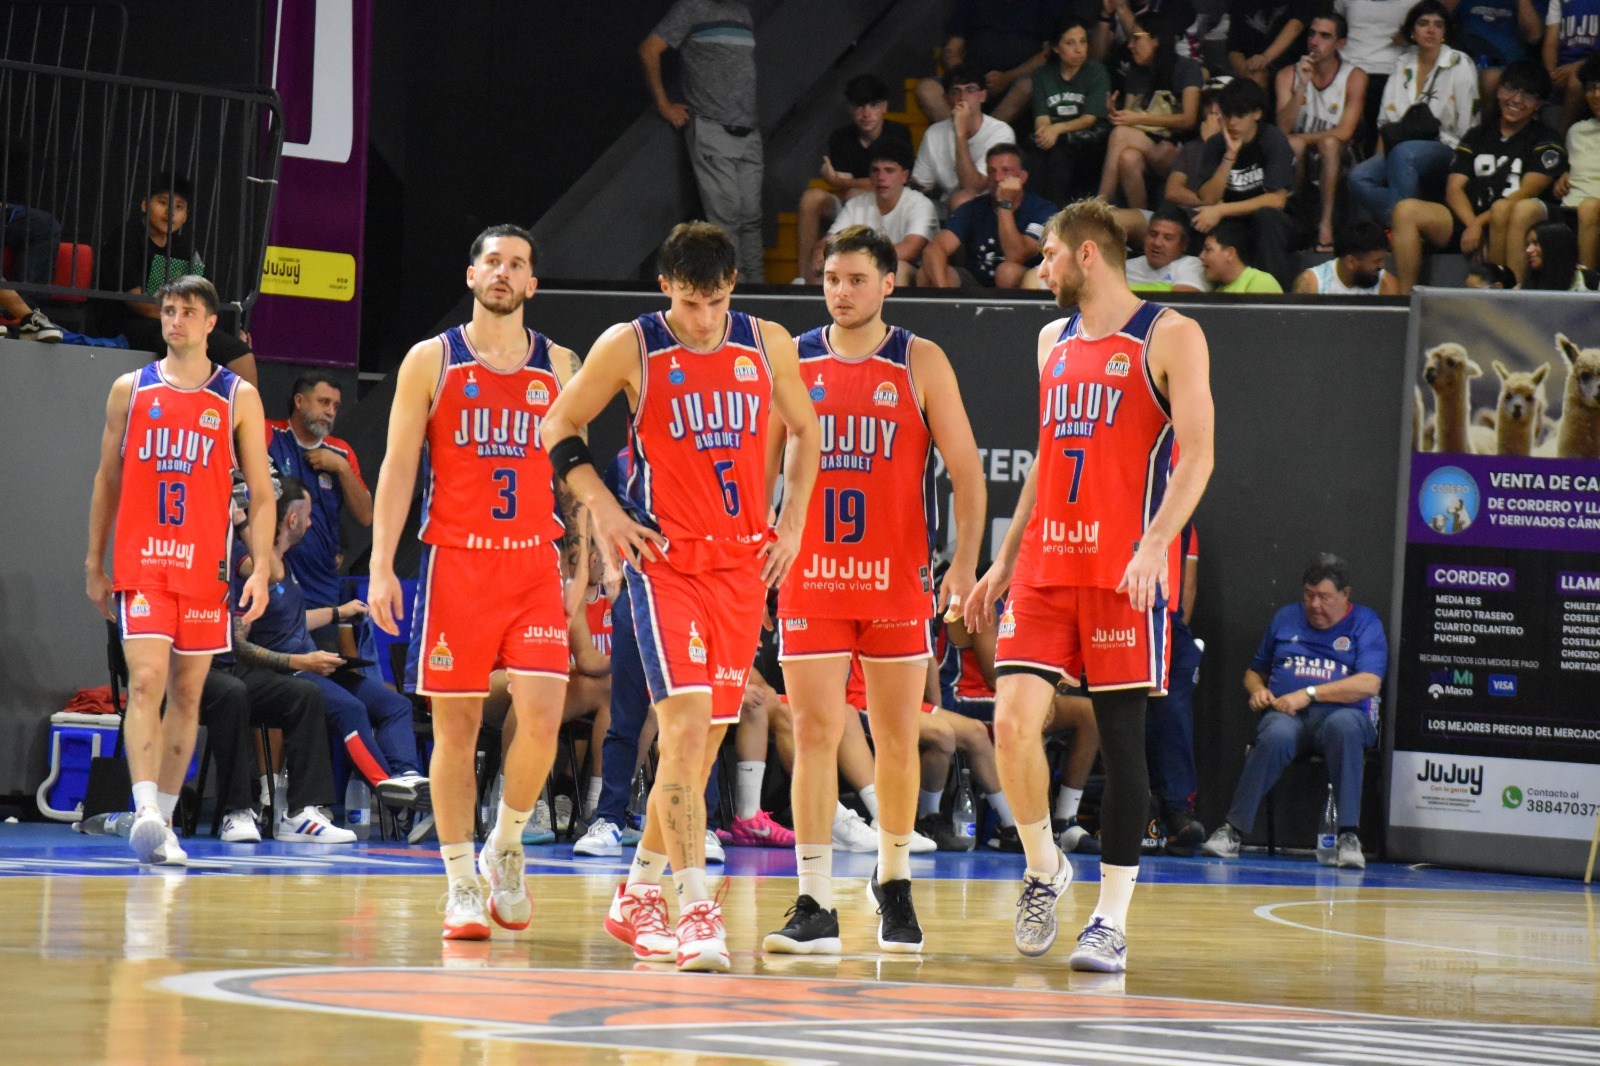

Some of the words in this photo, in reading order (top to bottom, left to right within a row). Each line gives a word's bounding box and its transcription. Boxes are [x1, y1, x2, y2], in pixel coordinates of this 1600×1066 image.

[1042, 382, 1124, 428] JUJUY
[668, 391, 760, 440] JUJUY
[819, 414, 898, 460] UJUY
[1054, 421, 1095, 440] BASQUET
[138, 428, 215, 467] JUJUY
[694, 432, 741, 451] BASQUET
[477, 444, 526, 458] BASQUET
[156, 459, 192, 475] BASQUET
[821, 454, 873, 473] BASQUET
[1063, 448, 1085, 504] 7
[1489, 471, 1546, 490] VENTA
[1548, 474, 1571, 491] DE
[1574, 475, 1600, 491] CA
[491, 468, 517, 520] 3
[714, 459, 741, 517] 6
[158, 481, 187, 526] 13
[1488, 497, 1505, 510] DE
[1507, 498, 1572, 513] CORDERO
[1573, 501, 1583, 513] Y
[1585, 501, 1600, 514] LL
[824, 487, 866, 543] 19
[1489, 513, 1497, 525] Y
[1499, 514, 1565, 529] DERIVADOS
[849, 580, 872, 591] viva
[1434, 568, 1510, 586] CORDERO
[1435, 594, 1464, 605] MEDIA
[1465, 595, 1482, 606] RES
[1435, 608, 1472, 618] CUARTO
[1473, 610, 1514, 621] TRASERO
[1563, 613, 1600, 623] COSTELE
[1434, 622, 1472, 632] CUARTO
[1472, 624, 1524, 635] DELANTERO
[1433, 633, 1476, 644] PUCHERO
[1419, 653, 1452, 663] RECIBIMOS
[1452, 655, 1474, 665] TODOS
[1474, 657, 1486, 665] LOS
[1487, 658, 1510, 667] MEDIOS
[1511, 659, 1520, 668] DE
[1520, 660, 1539, 669] PAGO
[1561, 649, 1600, 659] CHORIZO
[1295, 666, 1332, 680] BASQUET
[1444, 685, 1474, 696] Macro
[1493, 680, 1514, 691] VISA
[1428, 719, 1447, 730] LOS
[1447, 720, 1491, 733] MEJORES
[1492, 724, 1533, 736] PRECIOS
[1535, 726, 1552, 737] DEL
[1527, 787, 1569, 799] Contacto
[1570, 790, 1580, 799] al
